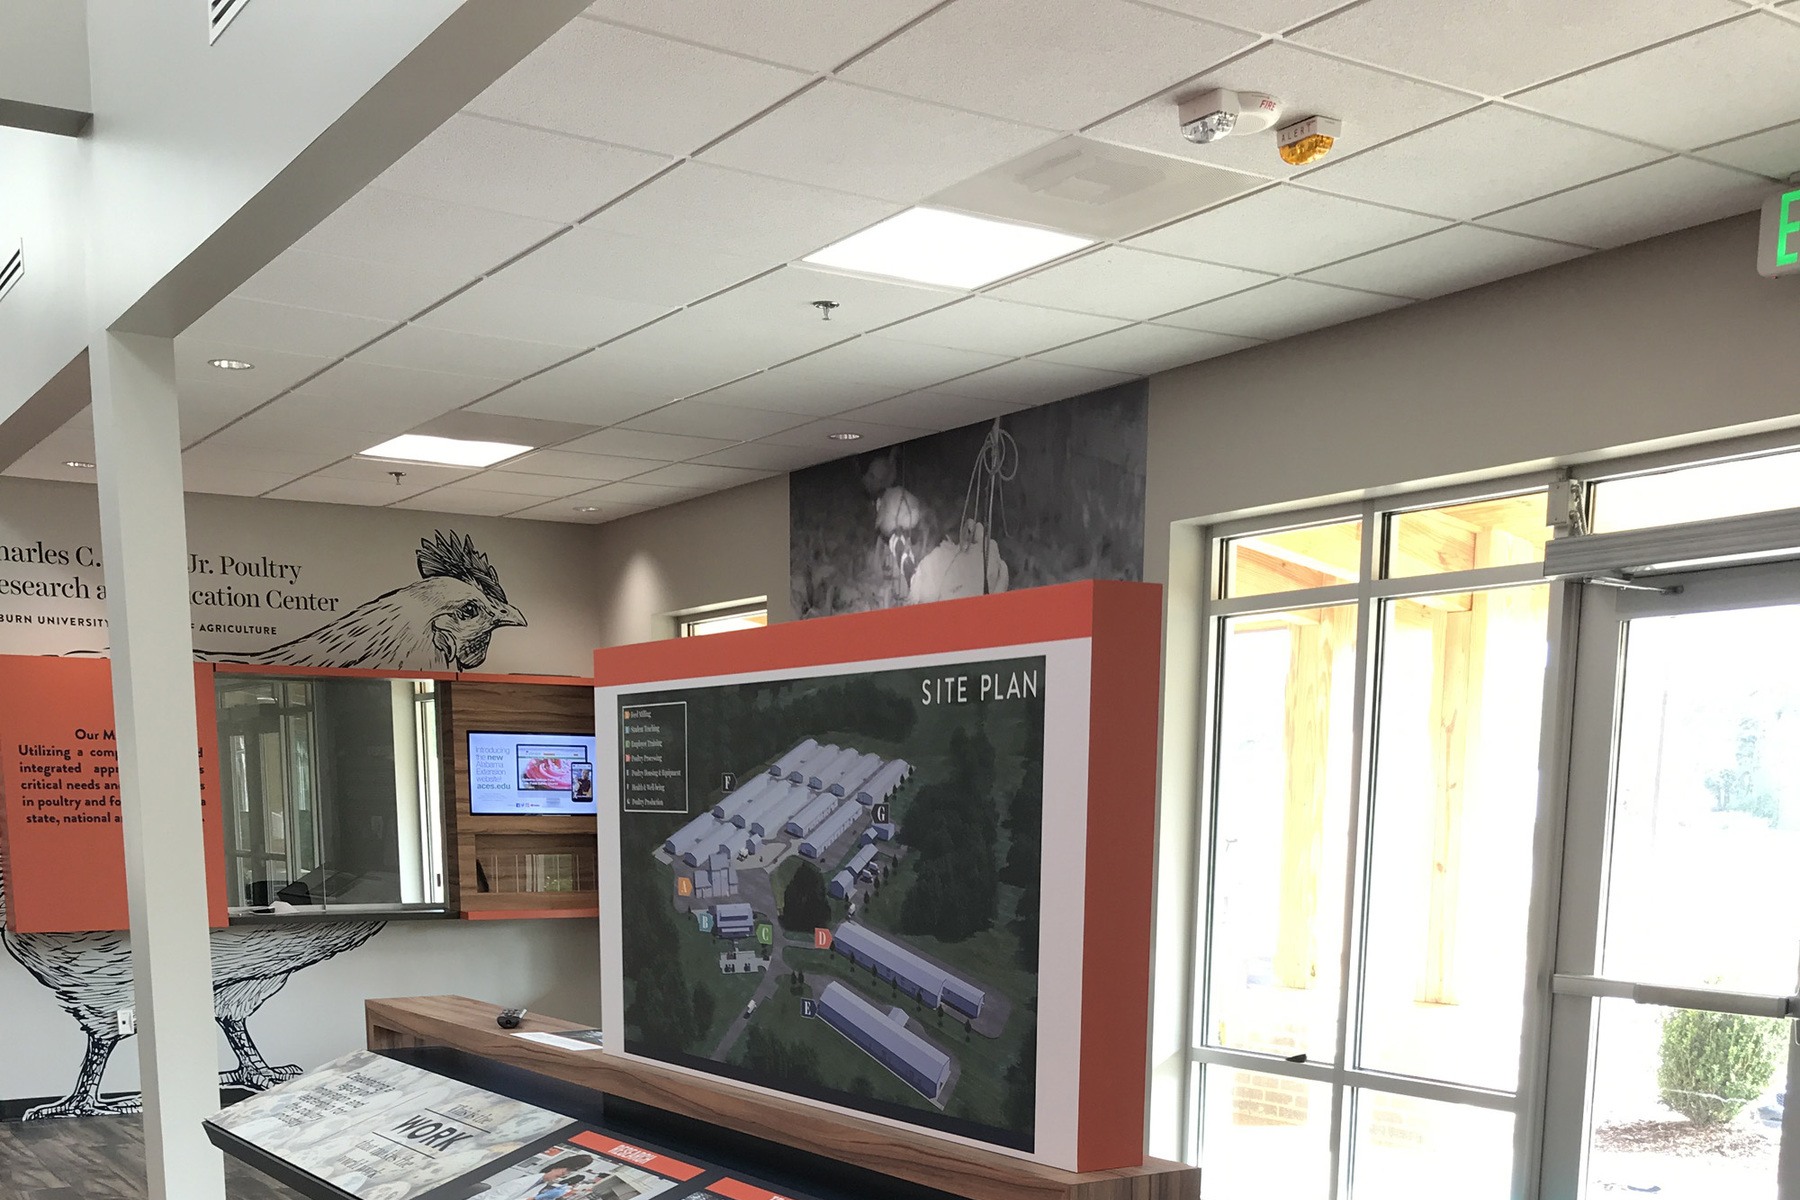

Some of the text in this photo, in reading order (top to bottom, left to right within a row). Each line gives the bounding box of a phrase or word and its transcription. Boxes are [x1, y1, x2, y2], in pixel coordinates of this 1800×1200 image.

[1259, 99, 1276, 111] FIRE
[1281, 123, 1312, 142] ALERT
[1776, 189, 1800, 267] E
[0, 541, 302, 585] harles C. Jr. Poultry
[0, 576, 90, 600] esearch
[190, 586, 260, 608] cation
[266, 589, 339, 612] Center
[0, 613, 32, 624] BURN
[199, 623, 277, 635] AGRICULTURE
[922, 670, 1037, 705] SITE PLAN
[75, 729, 99, 740] Our
[18, 745, 71, 760] Utilizing
[77, 749, 83, 757] a
[475, 746, 510, 755] Introducing
[19, 762, 82, 777] integrated
[476, 768, 507, 776] Extension
[21, 779, 120, 790] critical needs an
[724, 776, 732, 789] F
[22, 795, 121, 811] in poultry and fo
[26, 814, 60, 826] state,
[63, 812, 111, 823] national
[877, 806, 885, 821] G
[681, 880, 688, 893] A
[702, 916, 709, 928] B
[762, 927, 769, 940] C
[819, 932, 826, 945] D
[804, 1002, 811, 1016] E
[391, 1115, 473, 1151] WORK
[608, 1144, 657, 1165] RESEARCH
